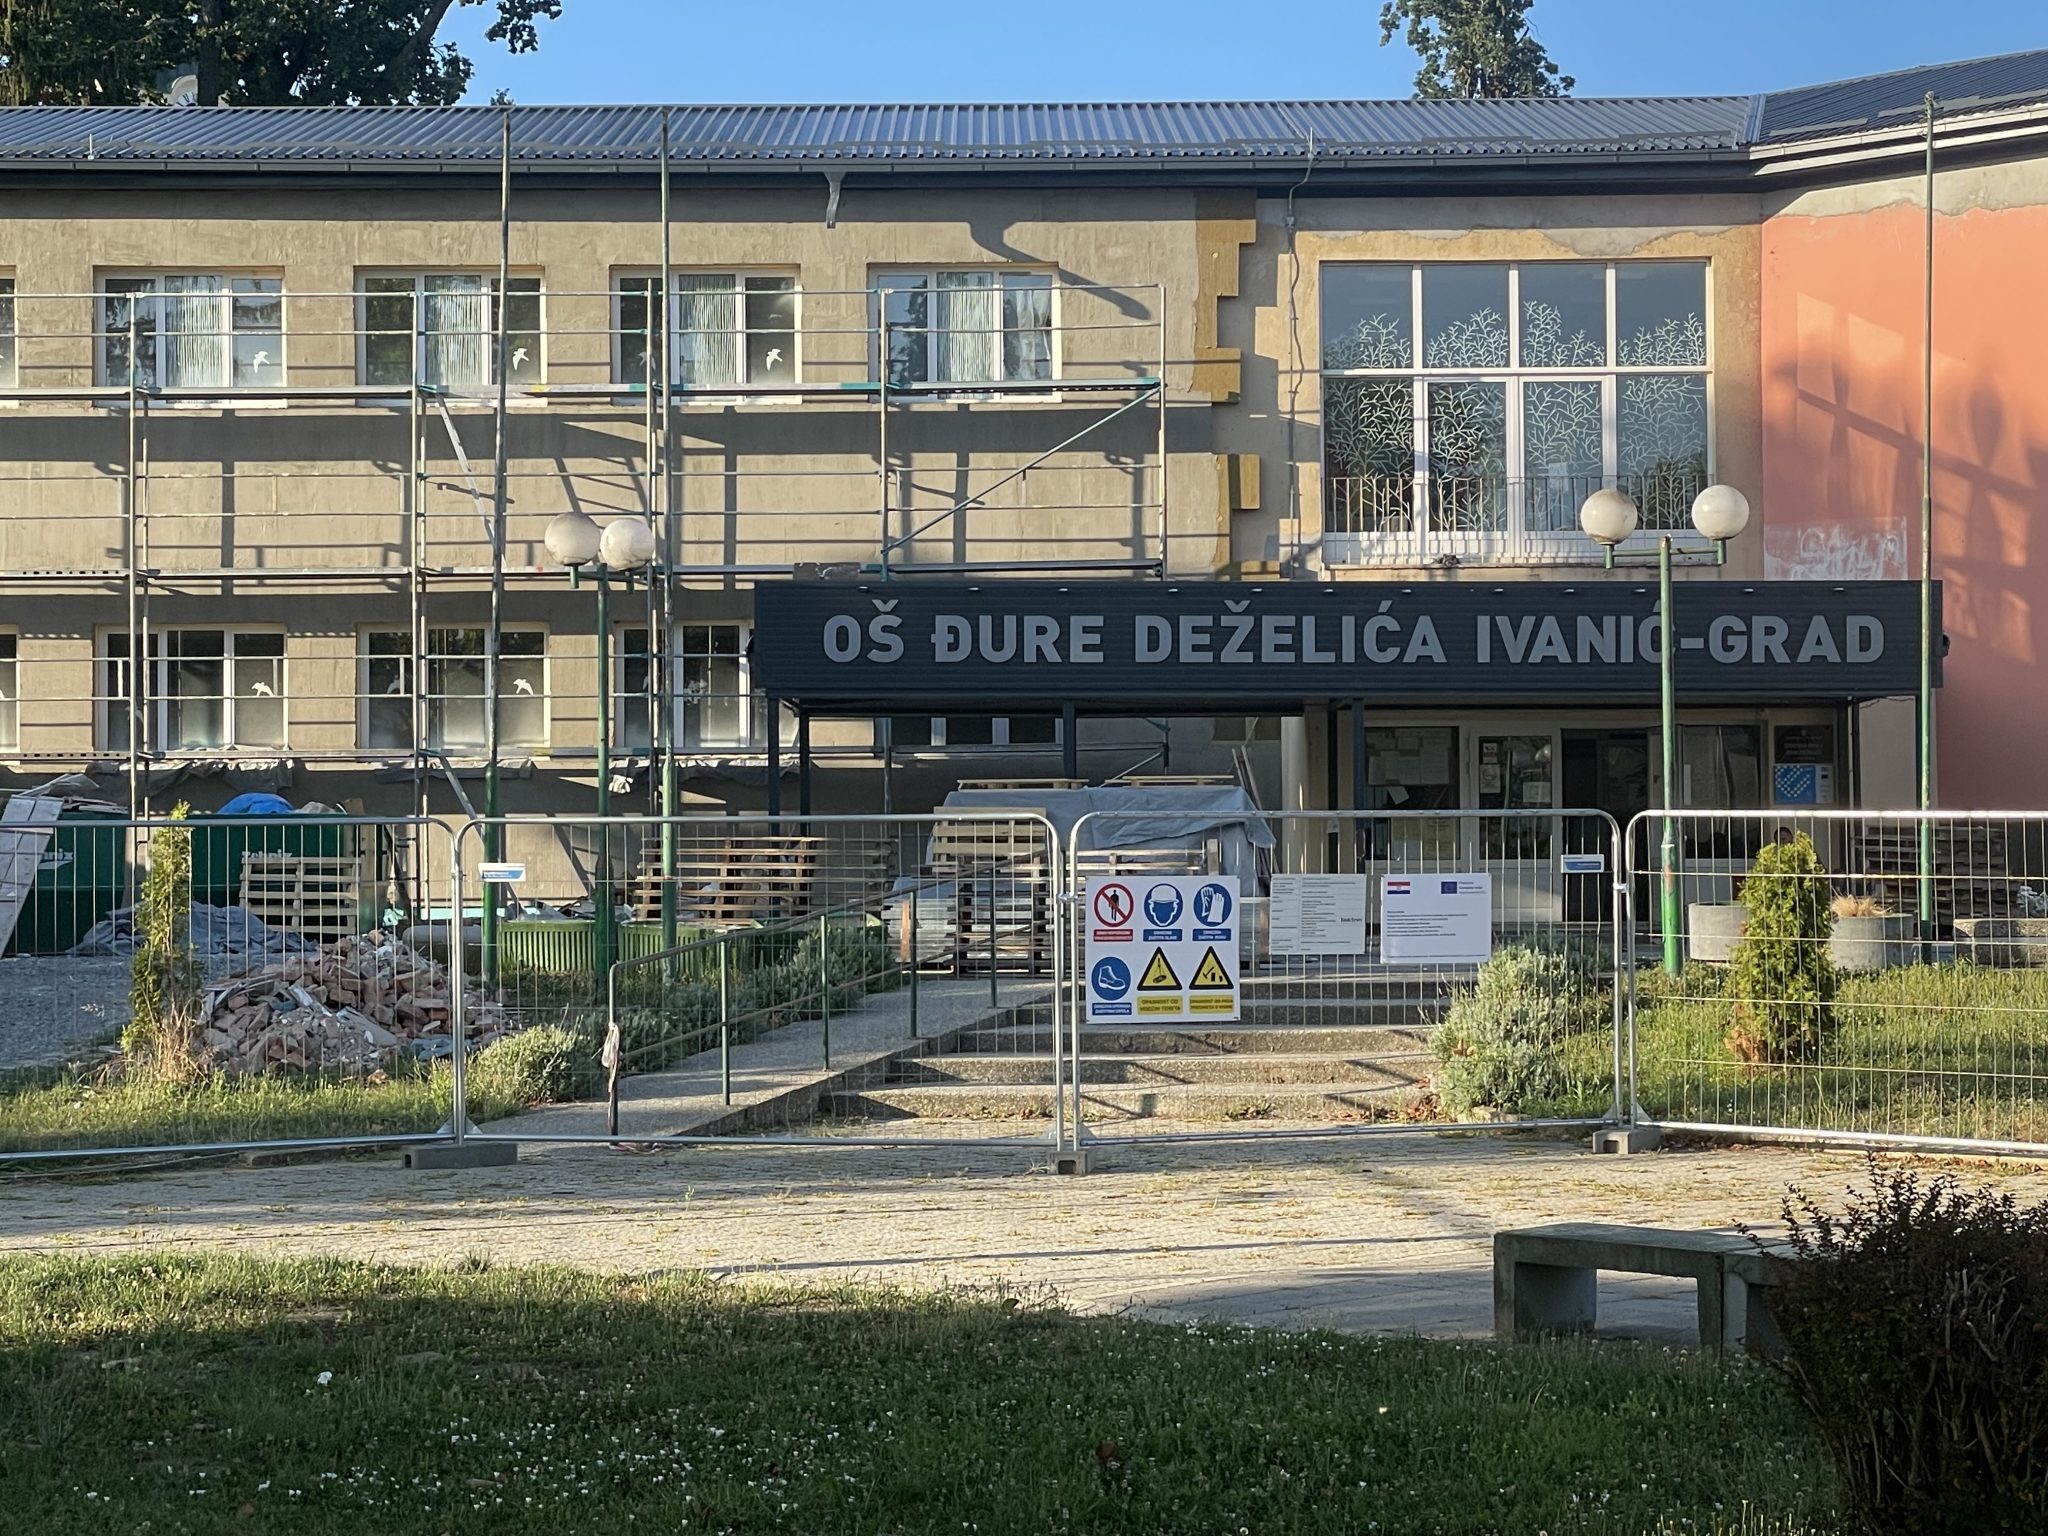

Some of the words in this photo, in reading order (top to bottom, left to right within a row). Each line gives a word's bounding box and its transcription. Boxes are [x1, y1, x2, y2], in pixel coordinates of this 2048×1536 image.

[823, 599, 905, 664] OŠ
[931, 614, 1104, 663] ĐURE
[1134, 600, 1448, 664] DEŽELIĆA
[1476, 600, 1886, 664] IVANIĆ-GRAD
